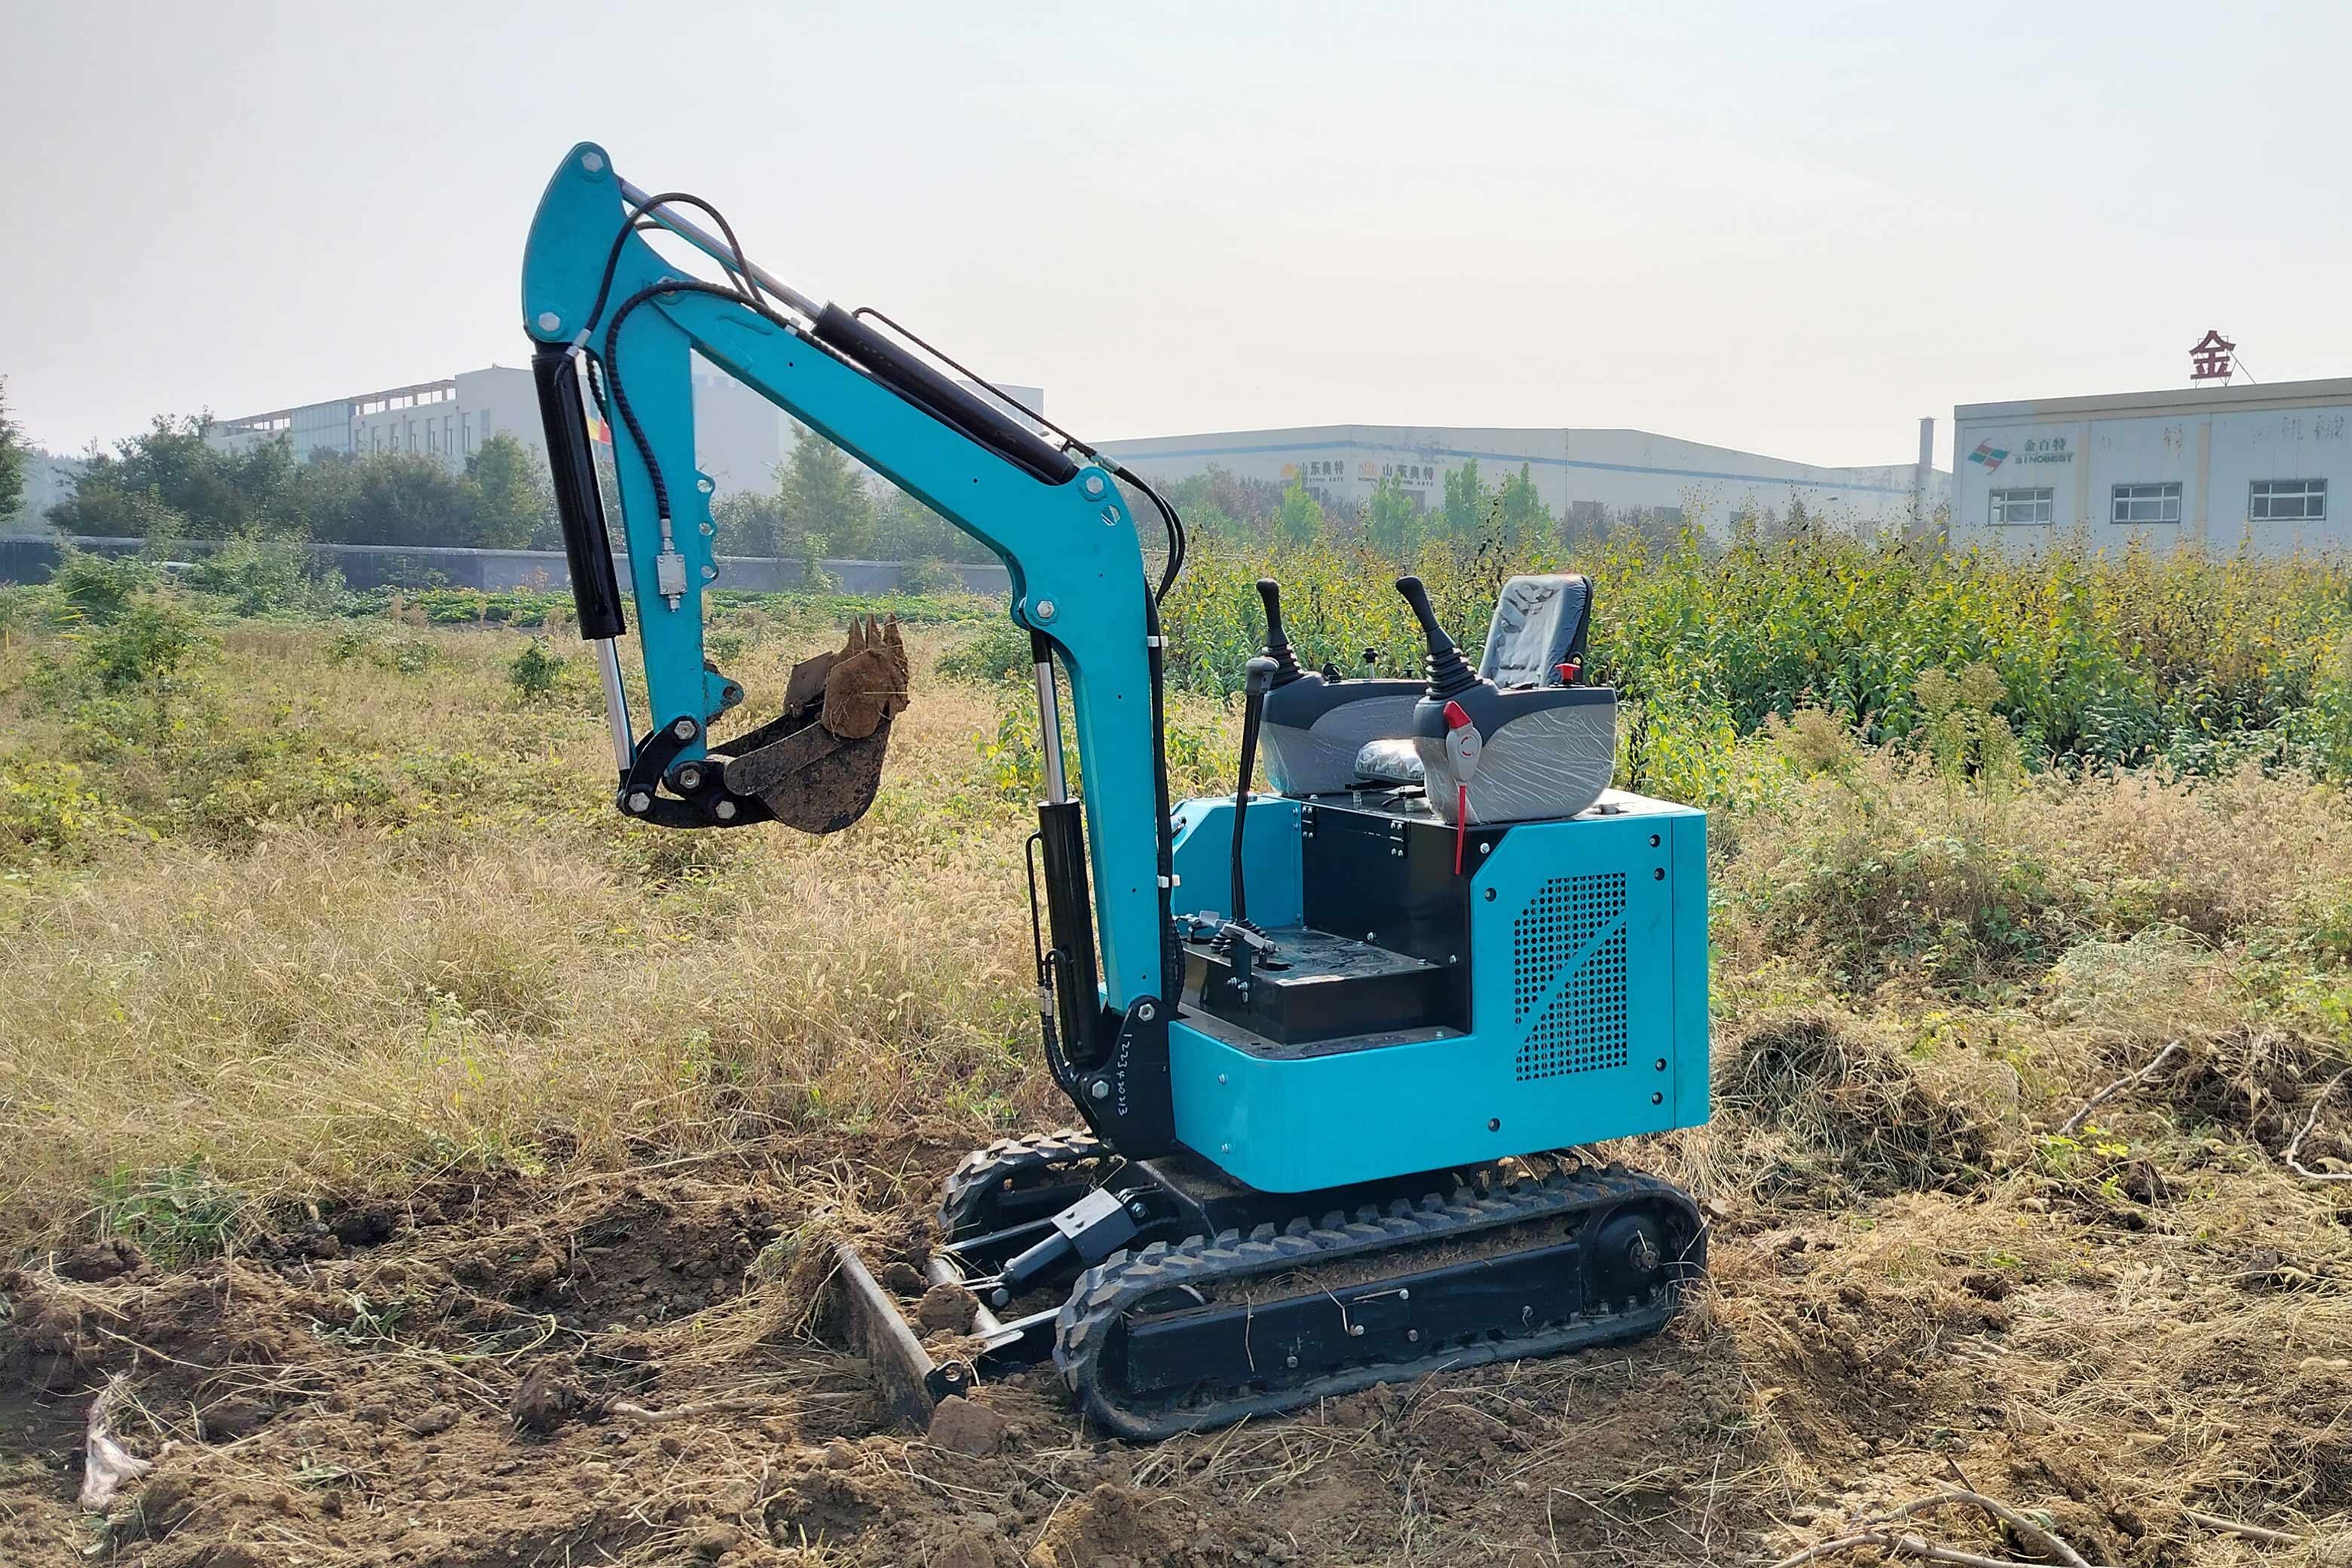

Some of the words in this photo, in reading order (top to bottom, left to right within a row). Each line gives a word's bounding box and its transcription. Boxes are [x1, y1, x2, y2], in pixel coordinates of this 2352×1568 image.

[2189, 330, 2236, 380] 金
[1299, 460, 1344, 476] 山东奥特
[1383, 463, 1434, 480] 山东奥特
